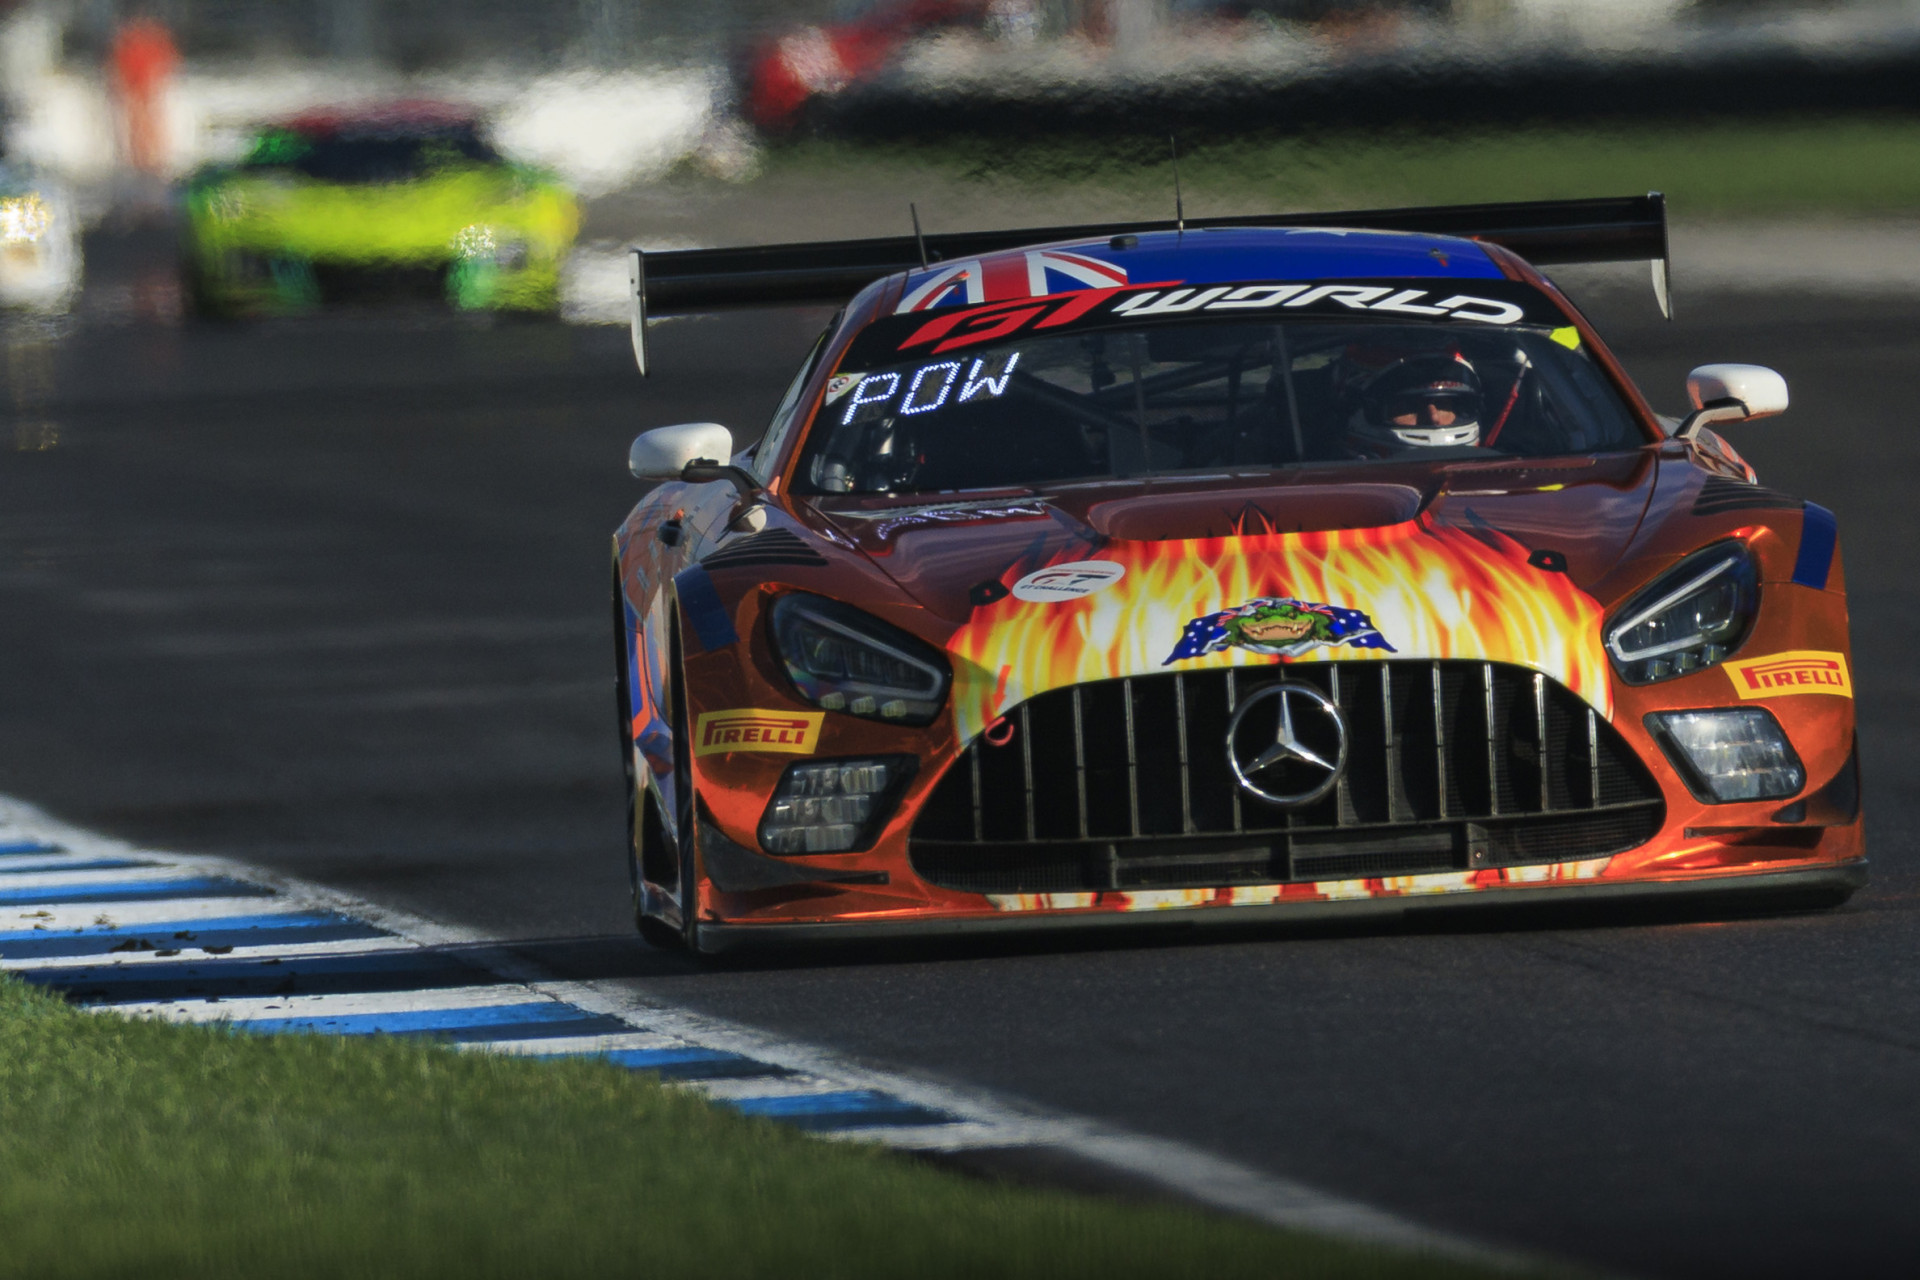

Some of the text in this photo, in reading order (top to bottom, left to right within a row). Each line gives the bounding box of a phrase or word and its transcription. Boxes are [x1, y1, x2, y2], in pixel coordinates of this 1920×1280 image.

[1111, 286, 1524, 325] WORLD
[842, 352, 1020, 425] POW
[1034, 585, 1089, 593] CHALLENGE
[1740, 660, 1843, 689] PIRELLI
[702, 717, 810, 747] PIRELLI
